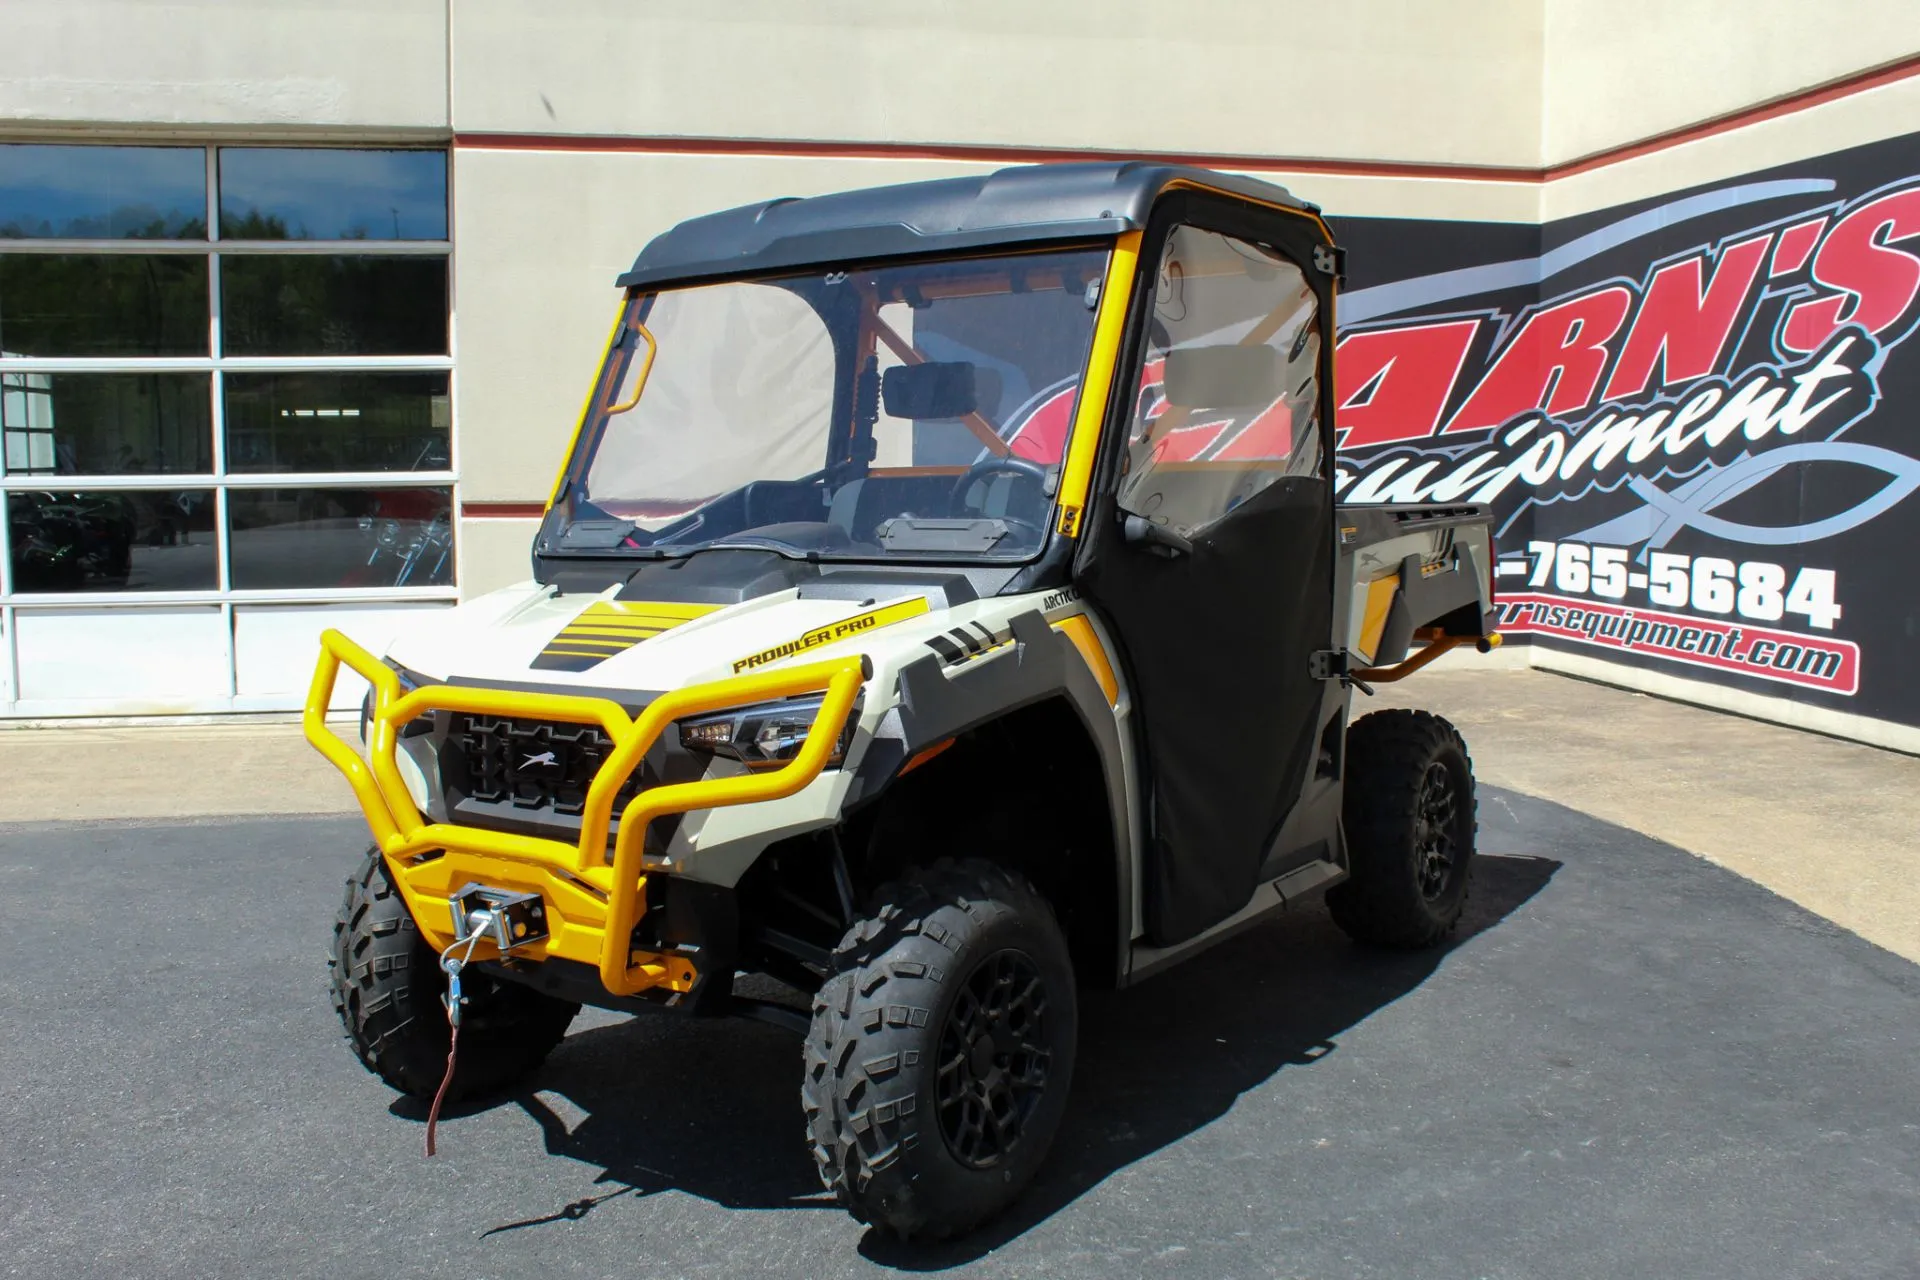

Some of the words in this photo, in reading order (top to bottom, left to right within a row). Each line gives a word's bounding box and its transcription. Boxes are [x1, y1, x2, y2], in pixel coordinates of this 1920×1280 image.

[1335, 336, 1857, 504] uipment
[1043, 590, 1073, 611] ARCTIC
[1494, 540, 1842, 630] -765-5684
[732, 630, 832, 674] PROWLER
[834, 615, 876, 637] PRO
